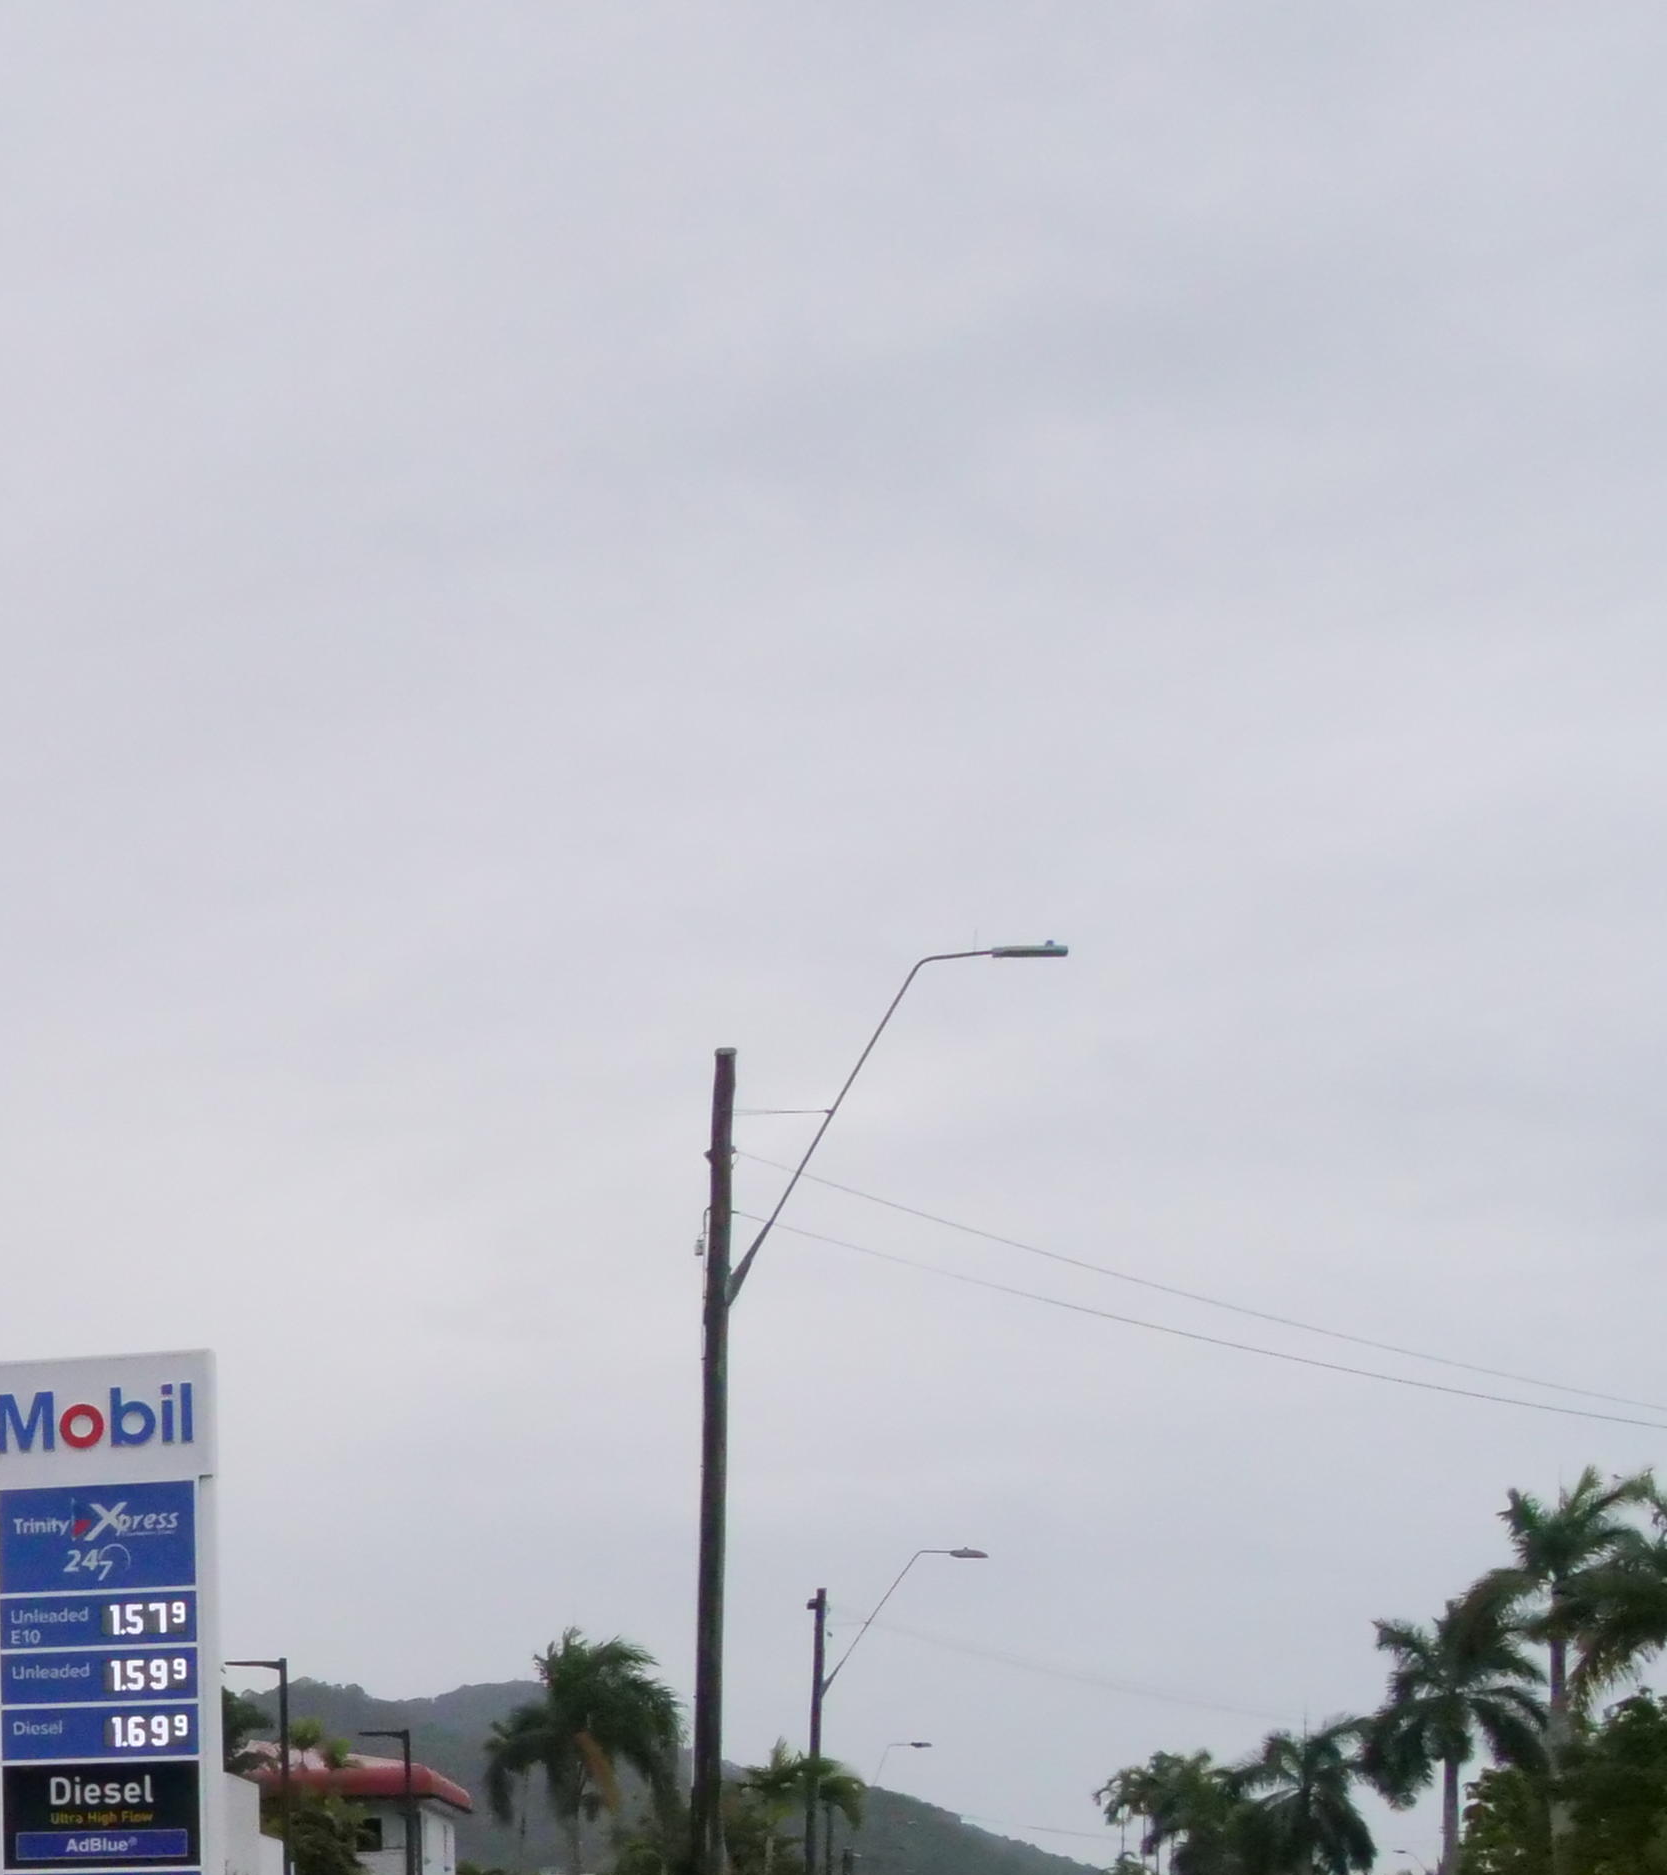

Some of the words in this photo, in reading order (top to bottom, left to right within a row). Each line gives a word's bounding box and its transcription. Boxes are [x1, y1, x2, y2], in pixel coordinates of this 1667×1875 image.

[13, 1518, 71, 1536] Trinity
[83, 1502, 179, 1541] Xpress
[10, 1607, 90, 1625] Unleaded
[10, 1630, 41, 1645] E10
[12, 1663, 91, 1680] Unleaded
[12, 1719, 64, 1736] Diesel
[50, 1774, 155, 1806] Diesel
[50, 1811, 84, 1825] Ultra
[87, 1811, 118, 1827] High
[121, 1809, 155, 1823] Flow
